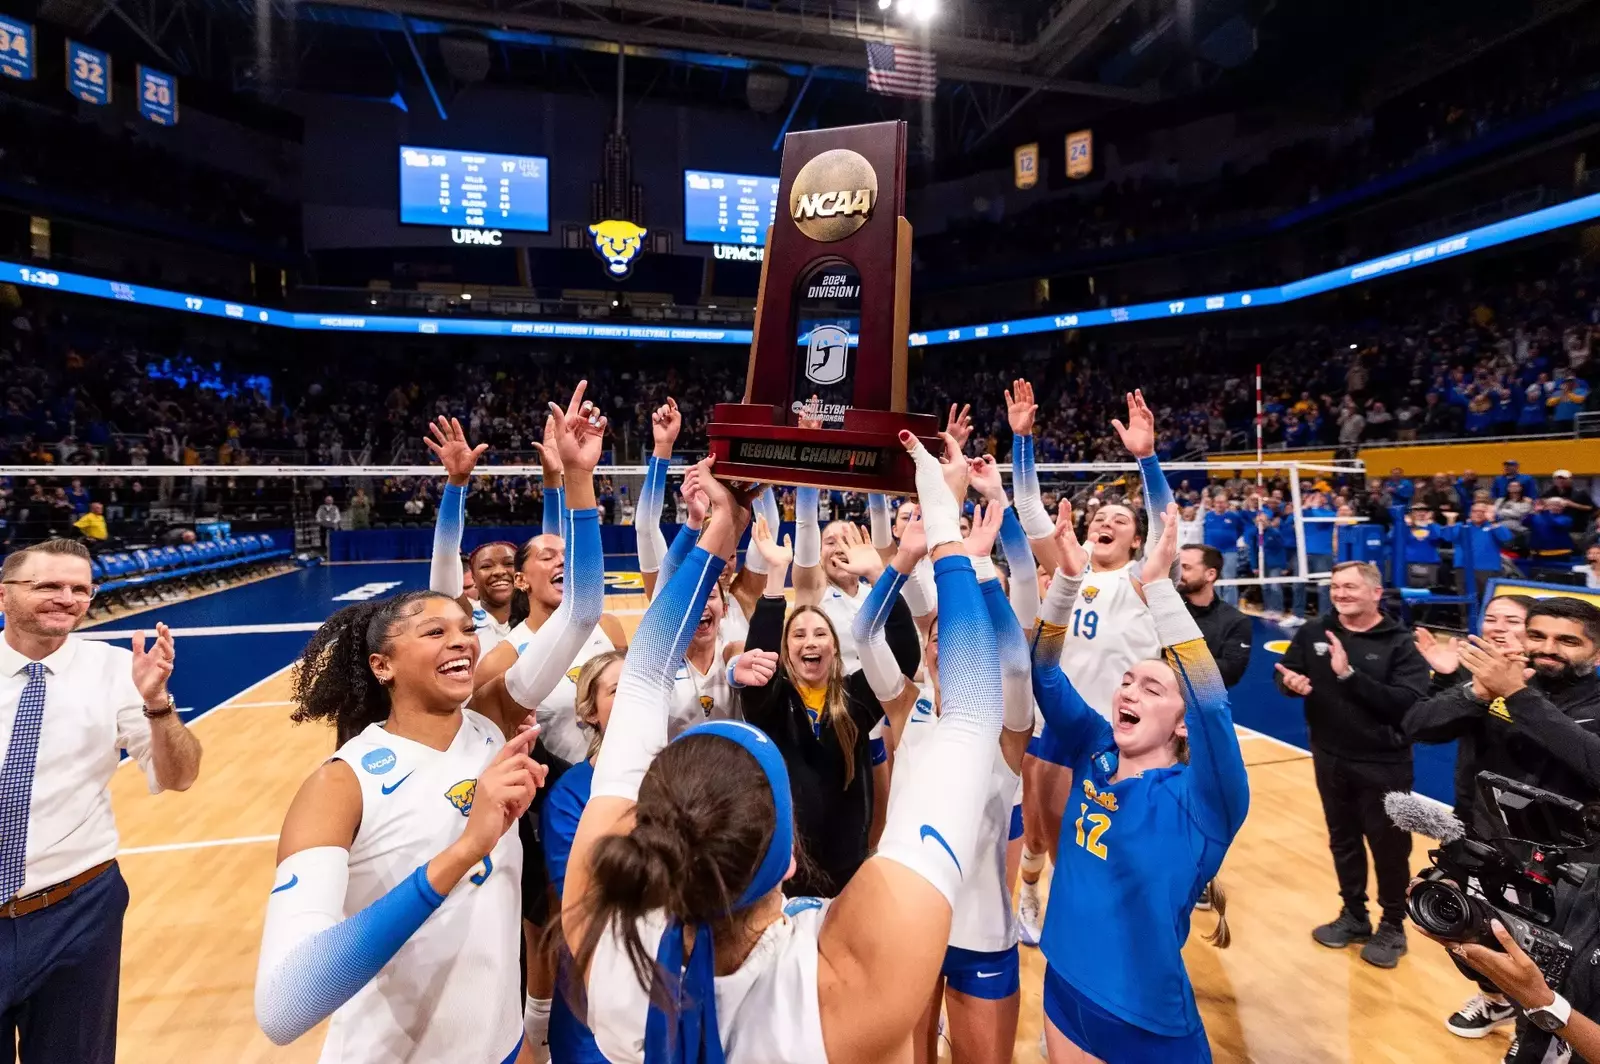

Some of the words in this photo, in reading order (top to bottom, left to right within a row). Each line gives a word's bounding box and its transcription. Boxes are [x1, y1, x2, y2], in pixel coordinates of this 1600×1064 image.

[74, 57, 104, 85] 32
[144, 81, 170, 106] 20
[1070, 143, 1087, 161] 24
[1020, 156, 1033, 172] 12
[793, 189, 872, 219] NCAA
[451, 228, 502, 246] UPMC
[713, 243, 757, 261] UPMC
[822, 275, 846, 285] 2024
[807, 286, 854, 298] DIVISION
[855, 286, 860, 297] I
[185, 297, 203, 310] 17
[1169, 301, 1185, 314] 17
[534, 324, 554, 334] NCAA
[555, 325, 588, 335] DIVISION
[593, 327, 628, 337] WOMEN'S
[630, 328, 669, 338] VOLLEYBALL
[671, 329, 725, 340] CHAMPIONSHIP
[804, 403, 854, 415] VOLLEYBA
[740, 442, 797, 461] REGIONAL
[800, 446, 878, 467] CHAMPION
[1074, 608, 1099, 640] 19
[367, 754, 395, 770] NCAA
[1075, 803, 1111, 861] 12
